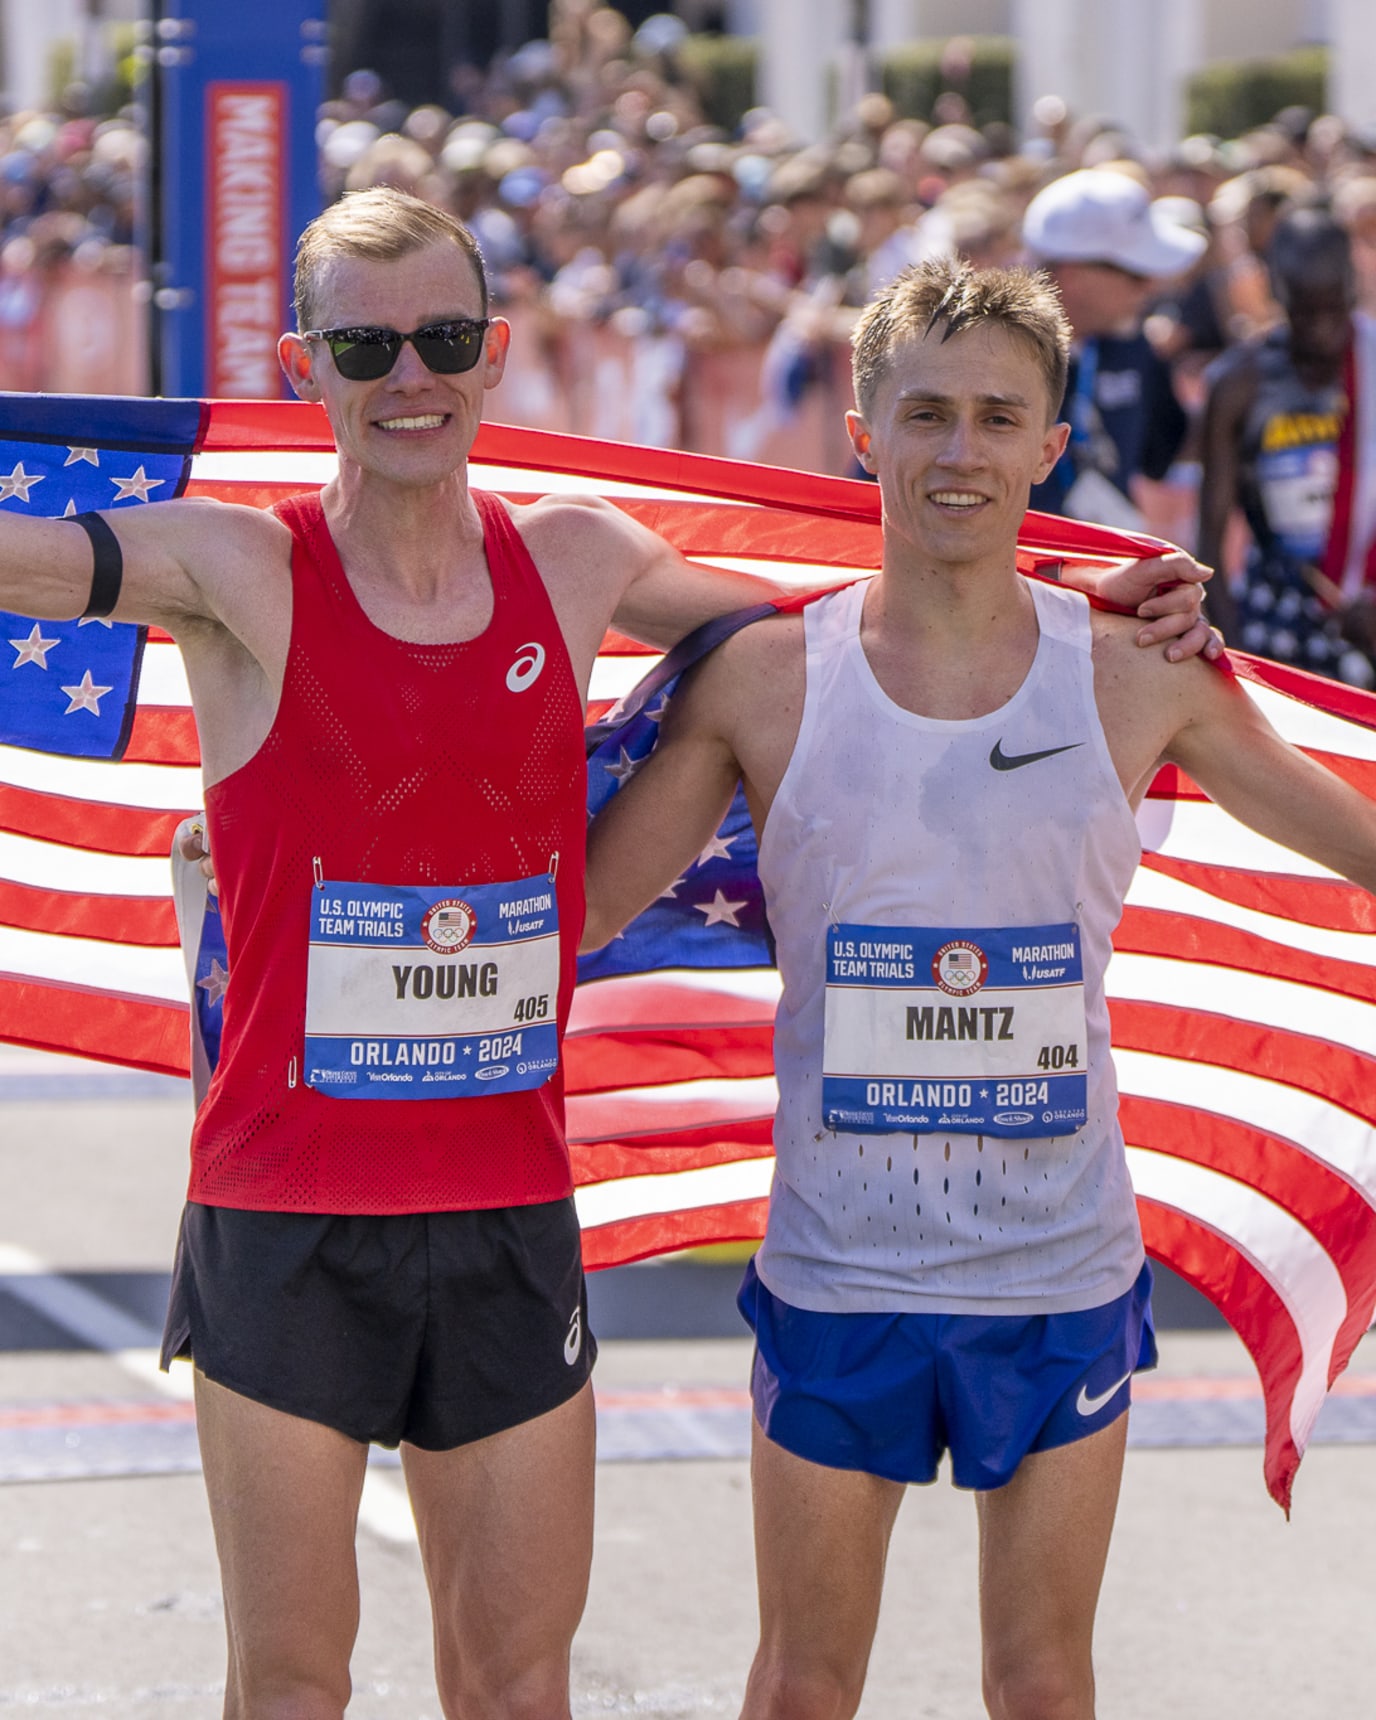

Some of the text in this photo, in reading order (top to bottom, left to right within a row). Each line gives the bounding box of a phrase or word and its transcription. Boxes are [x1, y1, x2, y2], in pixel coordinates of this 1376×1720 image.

[216, 94, 275, 396] MAKING TEAM
[320, 899, 404, 919] U.S. OLYMPIC
[428, 900, 473, 916] UNITED STATES
[499, 893, 552, 919] MARATHON
[319, 918, 404, 938] TEAM TRIALS
[518, 919, 544, 932] USATF
[834, 941, 913, 960] U.S. OLYMPIC
[938, 941, 982, 957] UNITED STATES
[1012, 943, 1075, 963] MARATHON
[833, 960, 914, 979] TEAM TRIALS
[1036, 968, 1066, 979] USATF
[392, 962, 498, 1000] YOUNG
[513, 994, 549, 1022] 405
[906, 1006, 1014, 1041] MANTZ
[351, 1033, 522, 1066] ORLANDO 2024
[1037, 1044, 1078, 1070] 404
[866, 1082, 1049, 1107] ORLANDO 2024
